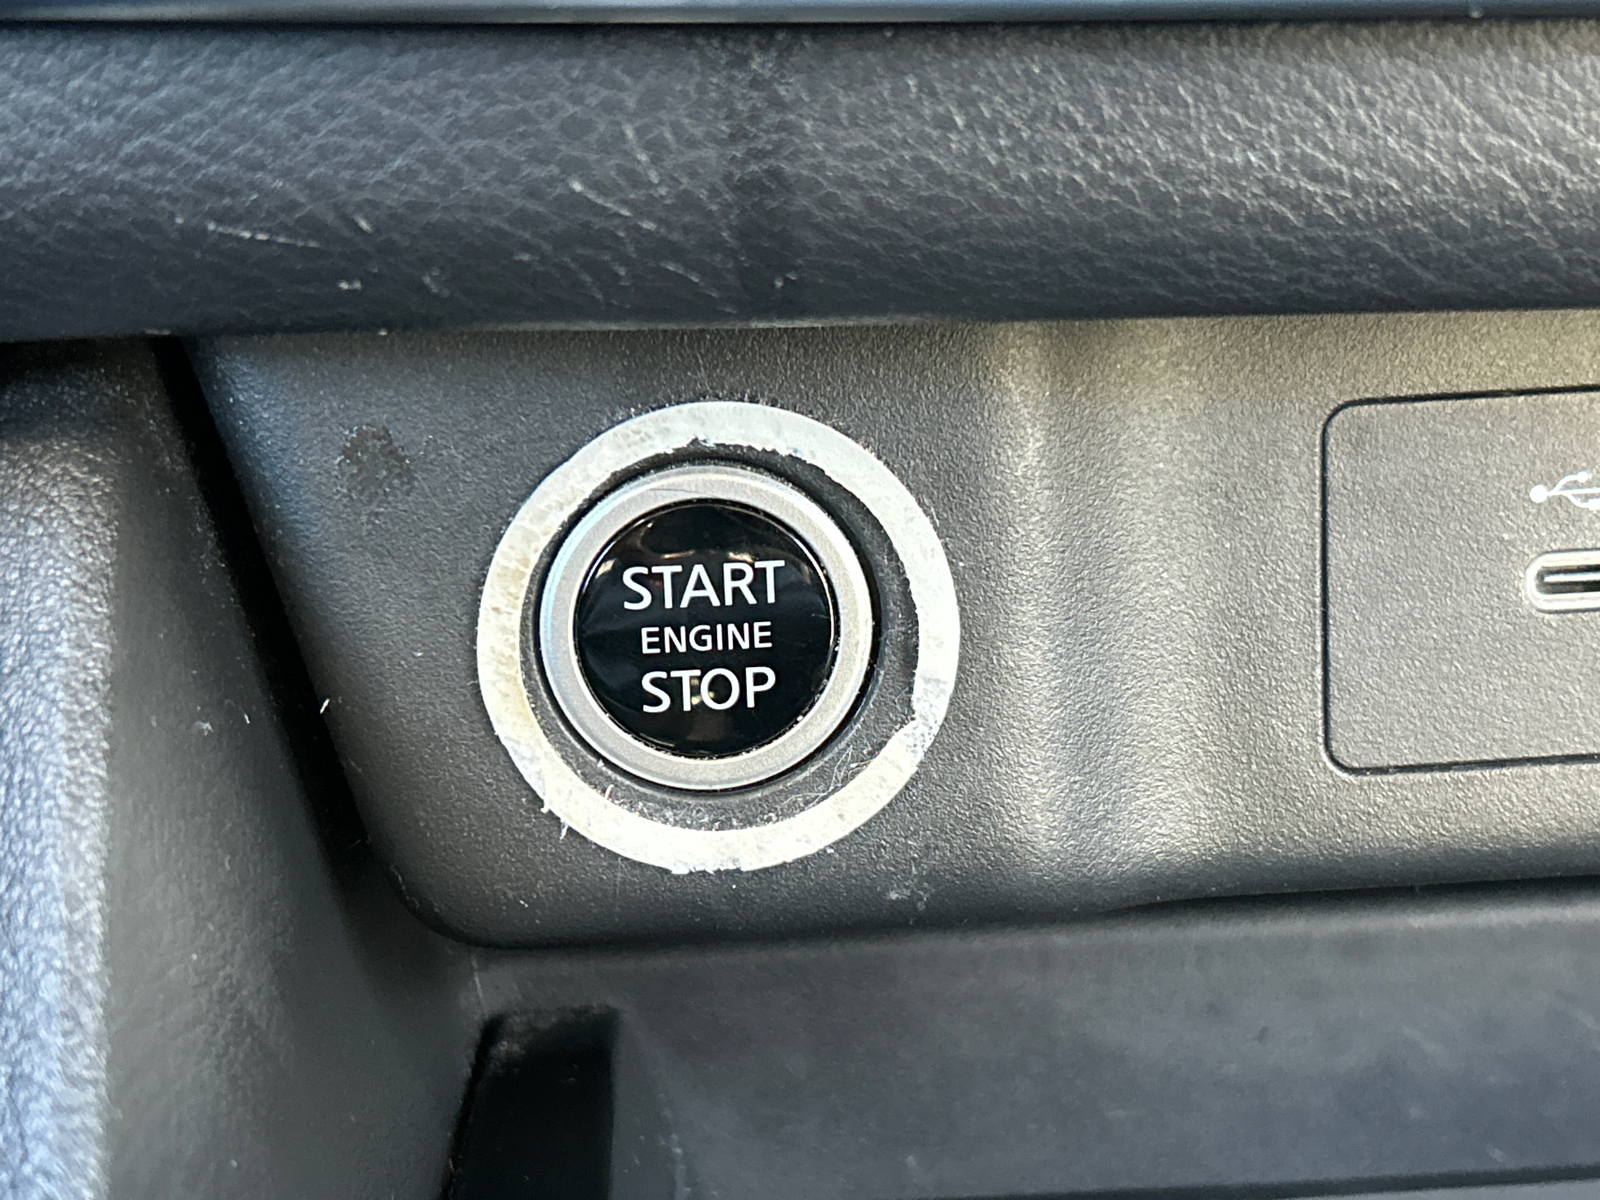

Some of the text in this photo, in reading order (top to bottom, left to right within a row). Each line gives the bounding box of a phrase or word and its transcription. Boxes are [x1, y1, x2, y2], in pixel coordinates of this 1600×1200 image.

[622, 559, 786, 610] START
[641, 621, 773, 654] ENGINE
[641, 666, 776, 713] STOP
